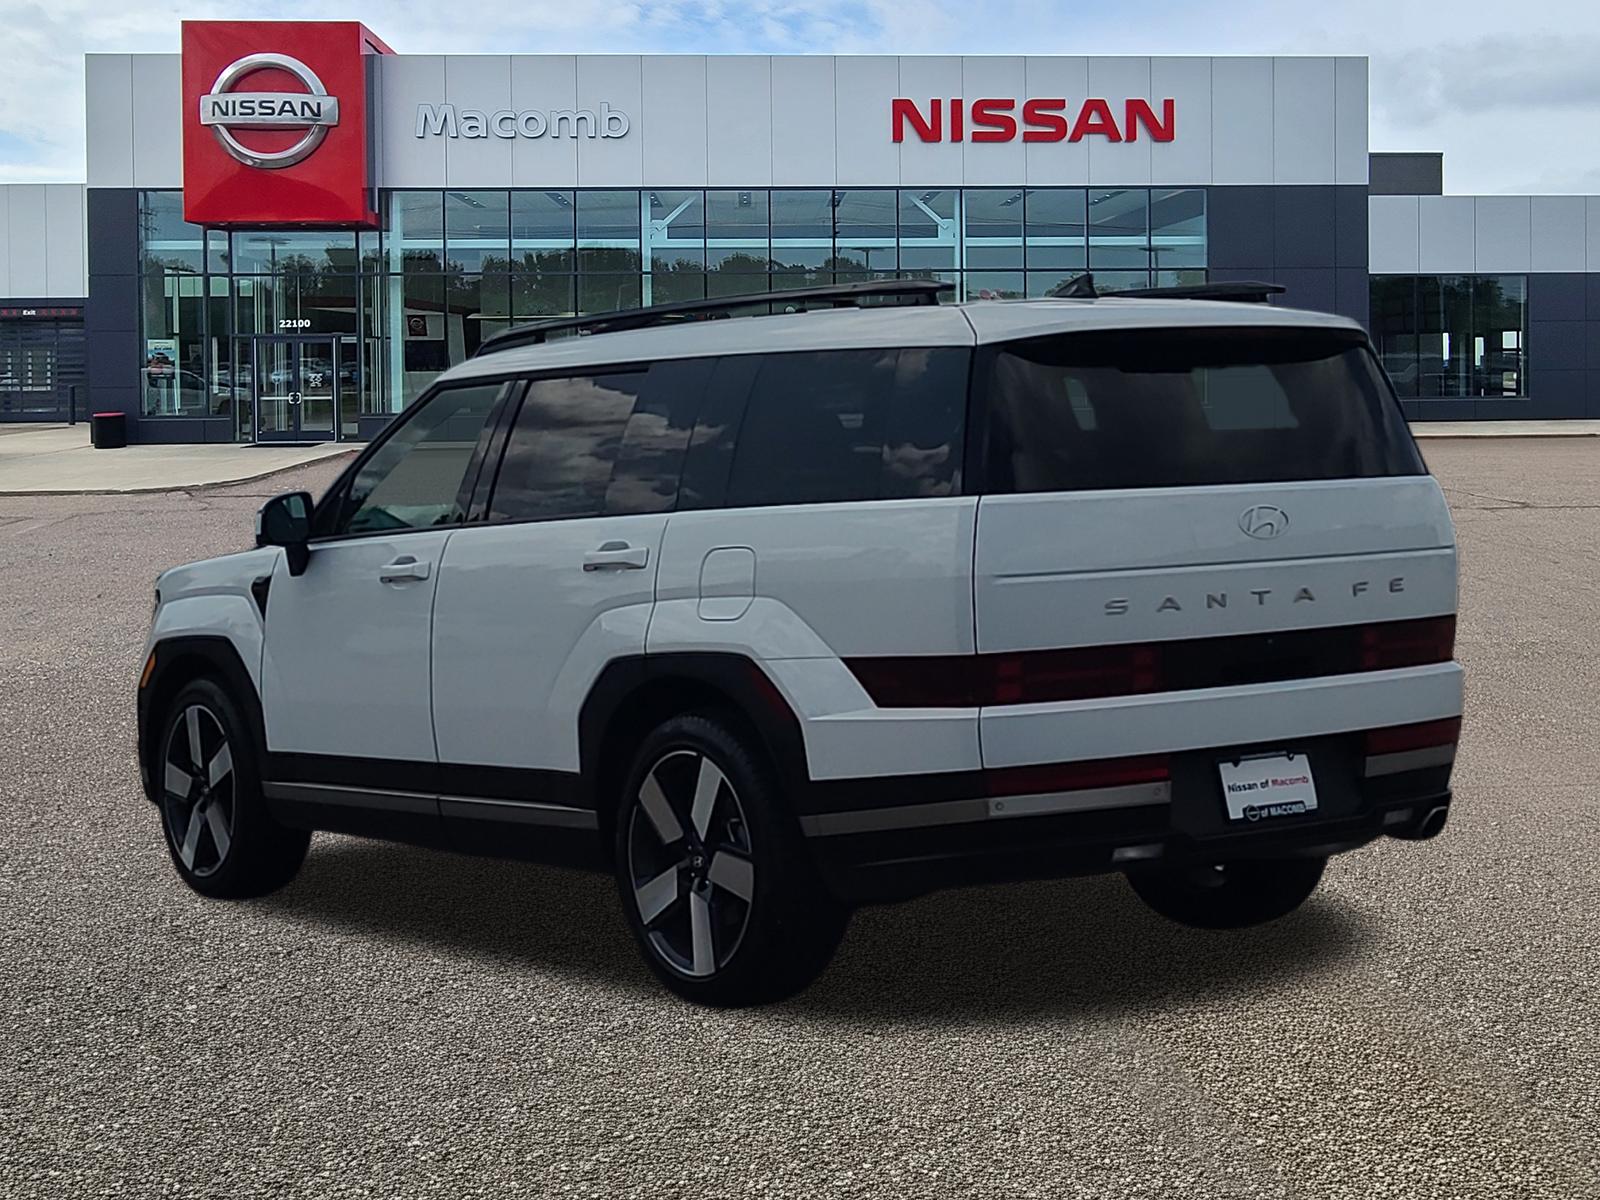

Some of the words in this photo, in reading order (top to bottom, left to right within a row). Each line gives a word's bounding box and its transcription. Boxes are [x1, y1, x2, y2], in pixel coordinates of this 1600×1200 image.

[211, 100, 322, 119] NISSAN
[415, 101, 630, 139] Macomb
[891, 98, 1175, 143] NISSAN
[279, 319, 311, 328] 22100
[1104, 587, 1315, 616] SANTA
[1352, 577, 1405, 598] FE
[1227, 782, 1258, 793] Nissan
[1260, 778, 1269, 789] of
[1271, 775, 1309, 787] Macomb
